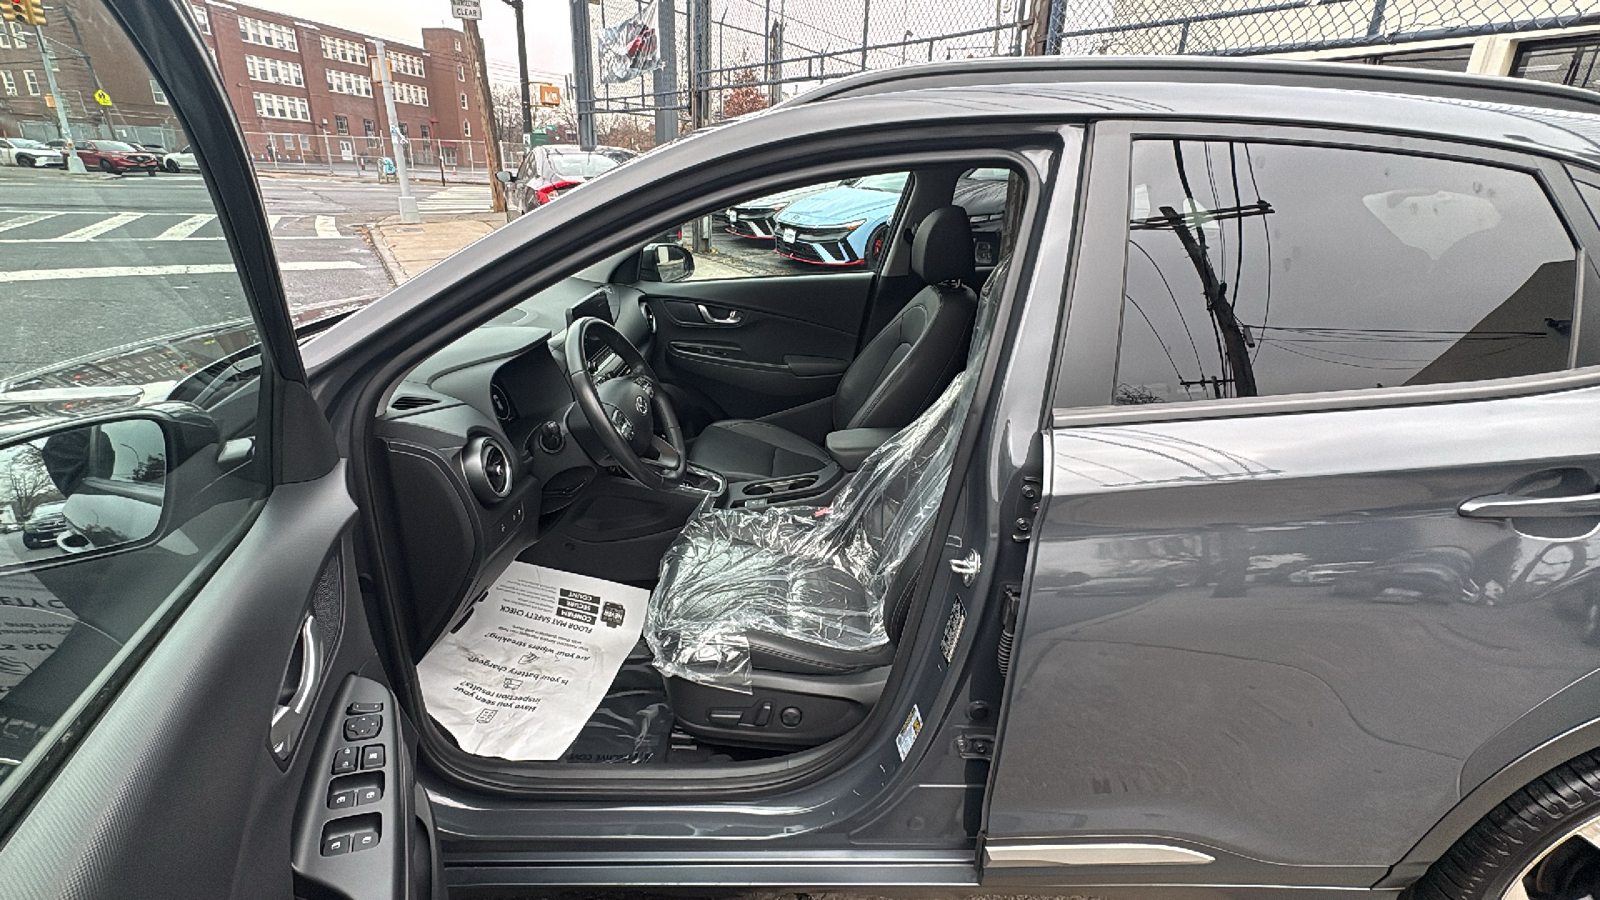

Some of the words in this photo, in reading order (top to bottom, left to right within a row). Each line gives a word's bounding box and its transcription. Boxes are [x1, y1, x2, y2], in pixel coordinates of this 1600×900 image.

[456, 8, 478, 17] CLEAR
[568, 591, 592, 601] COUNT
[500, 605, 524, 616] CHECK
[566, 601, 591, 611] SECURE
[524, 612, 551, 623] SAFETY
[561, 610, 592, 622] CONFIRM
[604, 610, 623, 619] NEVER
[551, 618, 567, 627] MAT
[568, 623, 592, 634] FLOOR
[484, 632, 527, 649] streaking?
[528, 644, 554, 653] wipers
[467, 656, 507, 672] charged?
[508, 668, 540, 681] battery
[453, 685, 475, 697] your
[460, 681, 495, 698] results?
[475, 695, 496, 705] seen
[495, 692, 541, 705] inspection
